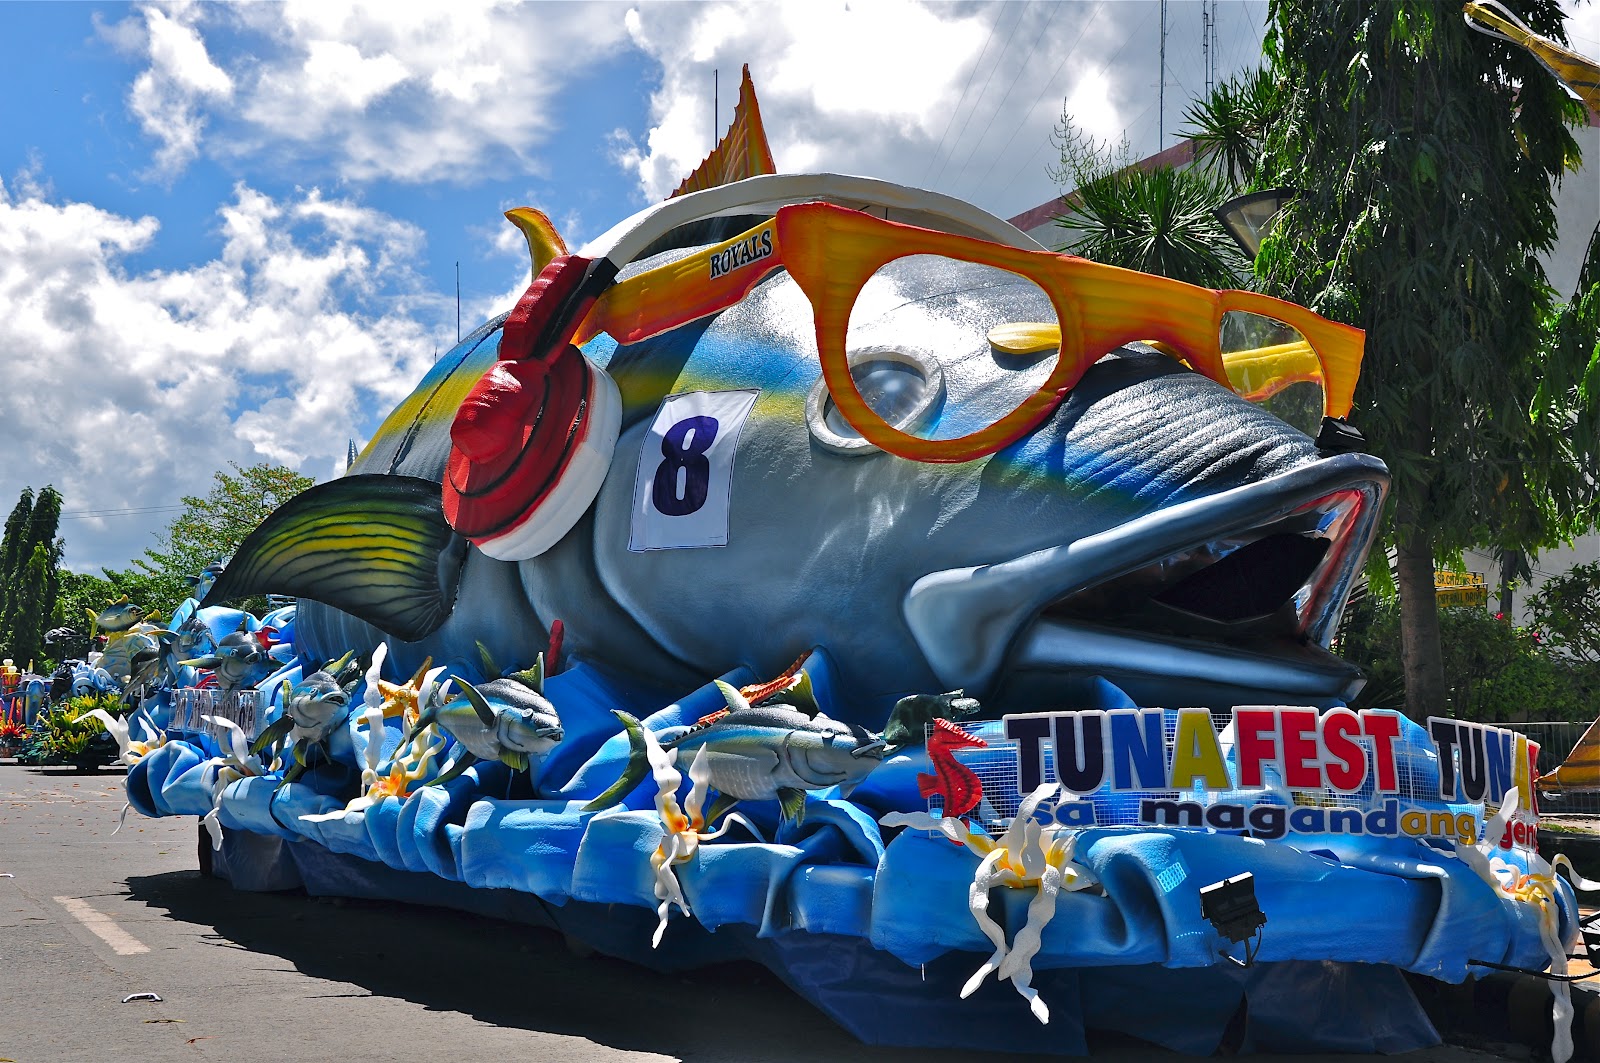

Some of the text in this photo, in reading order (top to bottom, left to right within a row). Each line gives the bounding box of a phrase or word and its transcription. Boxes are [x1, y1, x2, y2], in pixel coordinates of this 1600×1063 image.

[709, 228, 774, 280] ROYALS
[652, 415, 720, 517] 8
[1024, 797, 1476, 844] sa magandang
